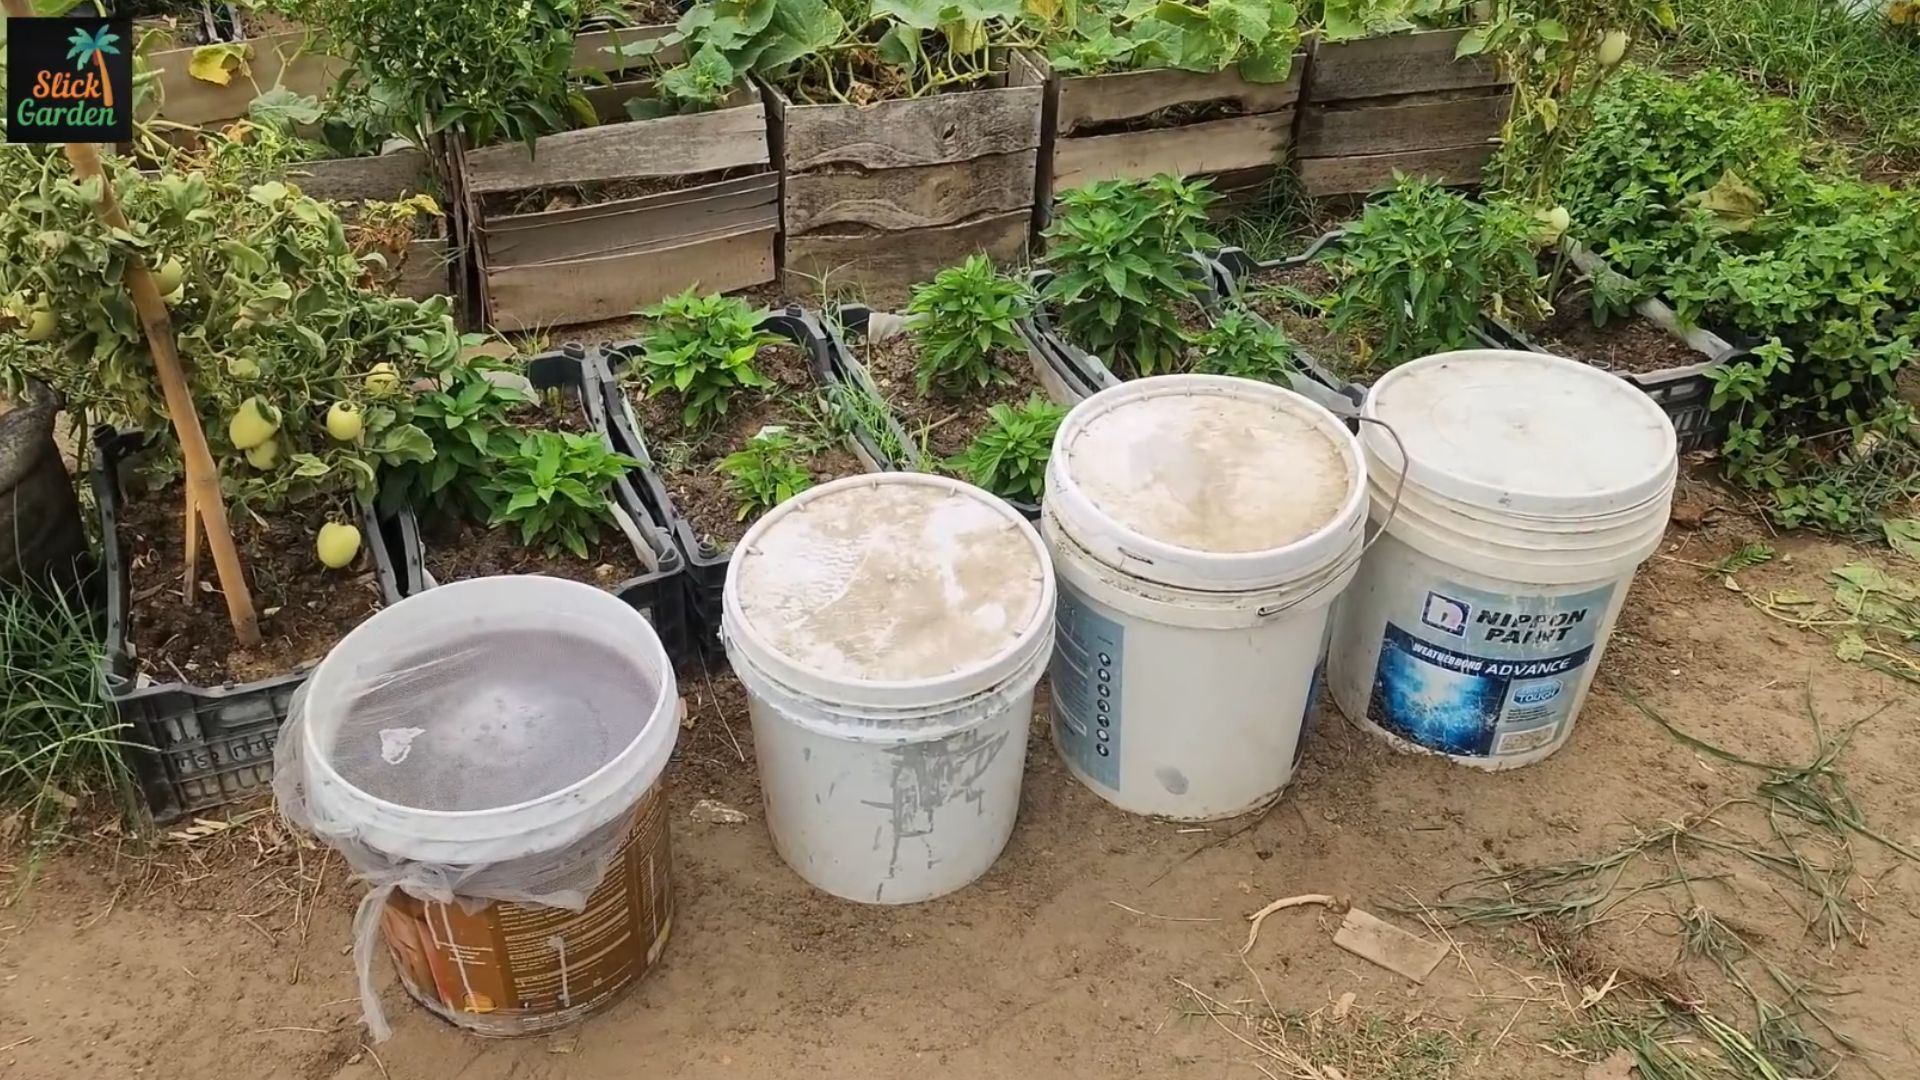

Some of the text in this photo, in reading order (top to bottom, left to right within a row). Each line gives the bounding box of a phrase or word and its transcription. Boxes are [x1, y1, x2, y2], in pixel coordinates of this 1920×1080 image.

[1476, 608, 1588, 628] NIPPON
[1484, 626, 1573, 645] PAINT
[1486, 657, 1570, 676] ADVANCE
